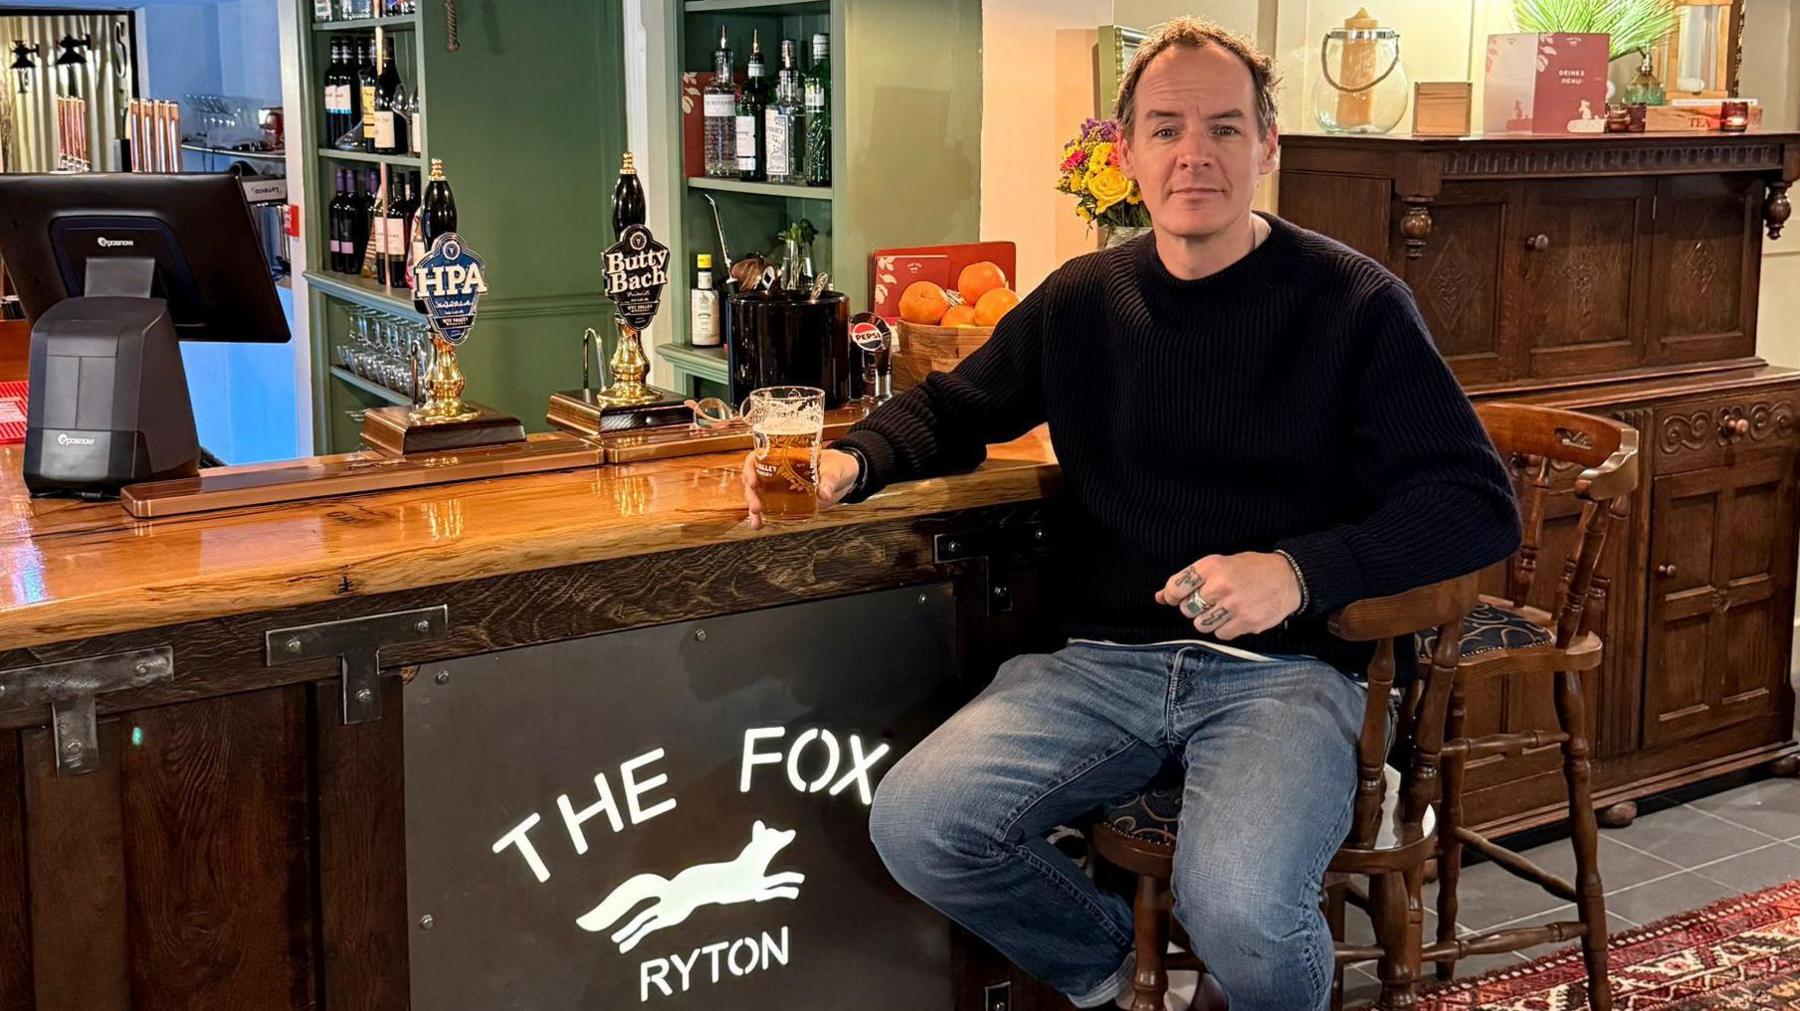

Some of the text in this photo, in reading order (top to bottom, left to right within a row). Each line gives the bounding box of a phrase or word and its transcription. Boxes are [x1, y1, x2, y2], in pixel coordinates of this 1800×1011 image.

[1558, 69, 1585, 77] DRINKS
[1688, 117, 1711, 128] TEA
[606, 248, 668, 274] Butty
[415, 262, 488, 297] HPA
[609, 265, 667, 294] Bach
[855, 332, 881, 341] PEPSI
[491, 726, 890, 883] THE FOX
[640, 926, 790, 1002] RYTON
